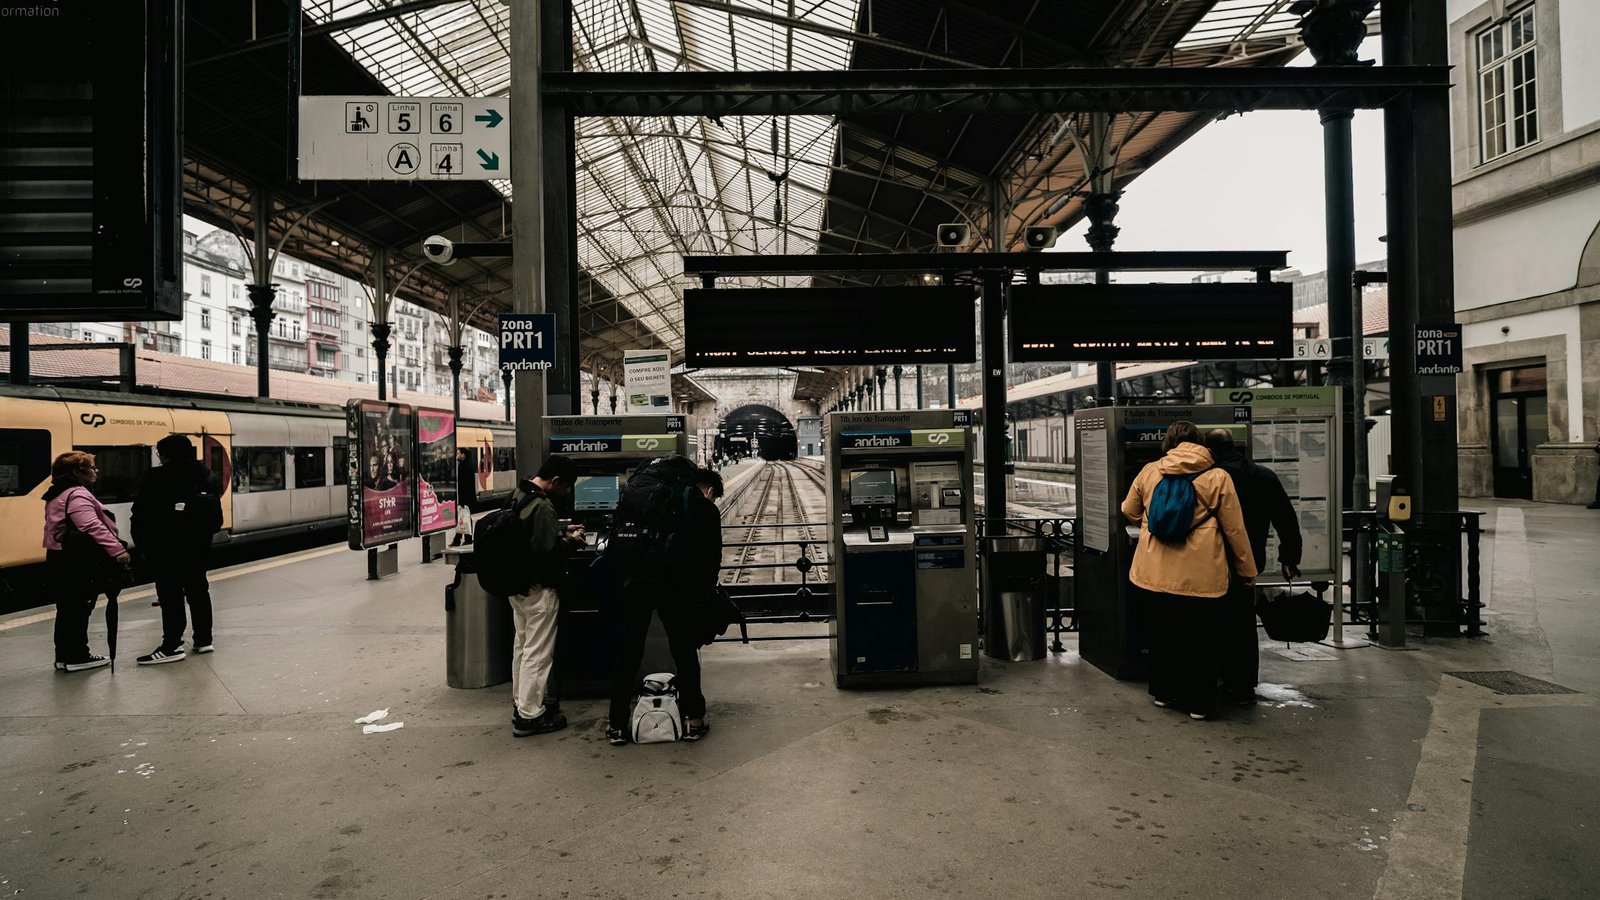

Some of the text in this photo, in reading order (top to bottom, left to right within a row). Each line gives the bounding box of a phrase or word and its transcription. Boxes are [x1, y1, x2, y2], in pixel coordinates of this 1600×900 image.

[0, 5, 60, 17] ormation
[398, 113, 411, 132] 5
[439, 114, 452, 132] 6
[394, 150, 414, 168] A
[438, 154, 453, 172] 4
[501, 320, 533, 330] zona
[1417, 329, 1442, 338] zona
[502, 331, 543, 349] PRT1
[1298, 346, 1304, 356] 5
[1317, 344, 1326, 354] A
[1365, 346, 1372, 355] 6
[1417, 340, 1452, 355] PRT1
[502, 358, 552, 370] andante
[1418, 364, 1460, 374] andante
[854, 435, 900, 447] andante
[1140, 429, 1166, 441] anda
[561, 440, 608, 452] andante
